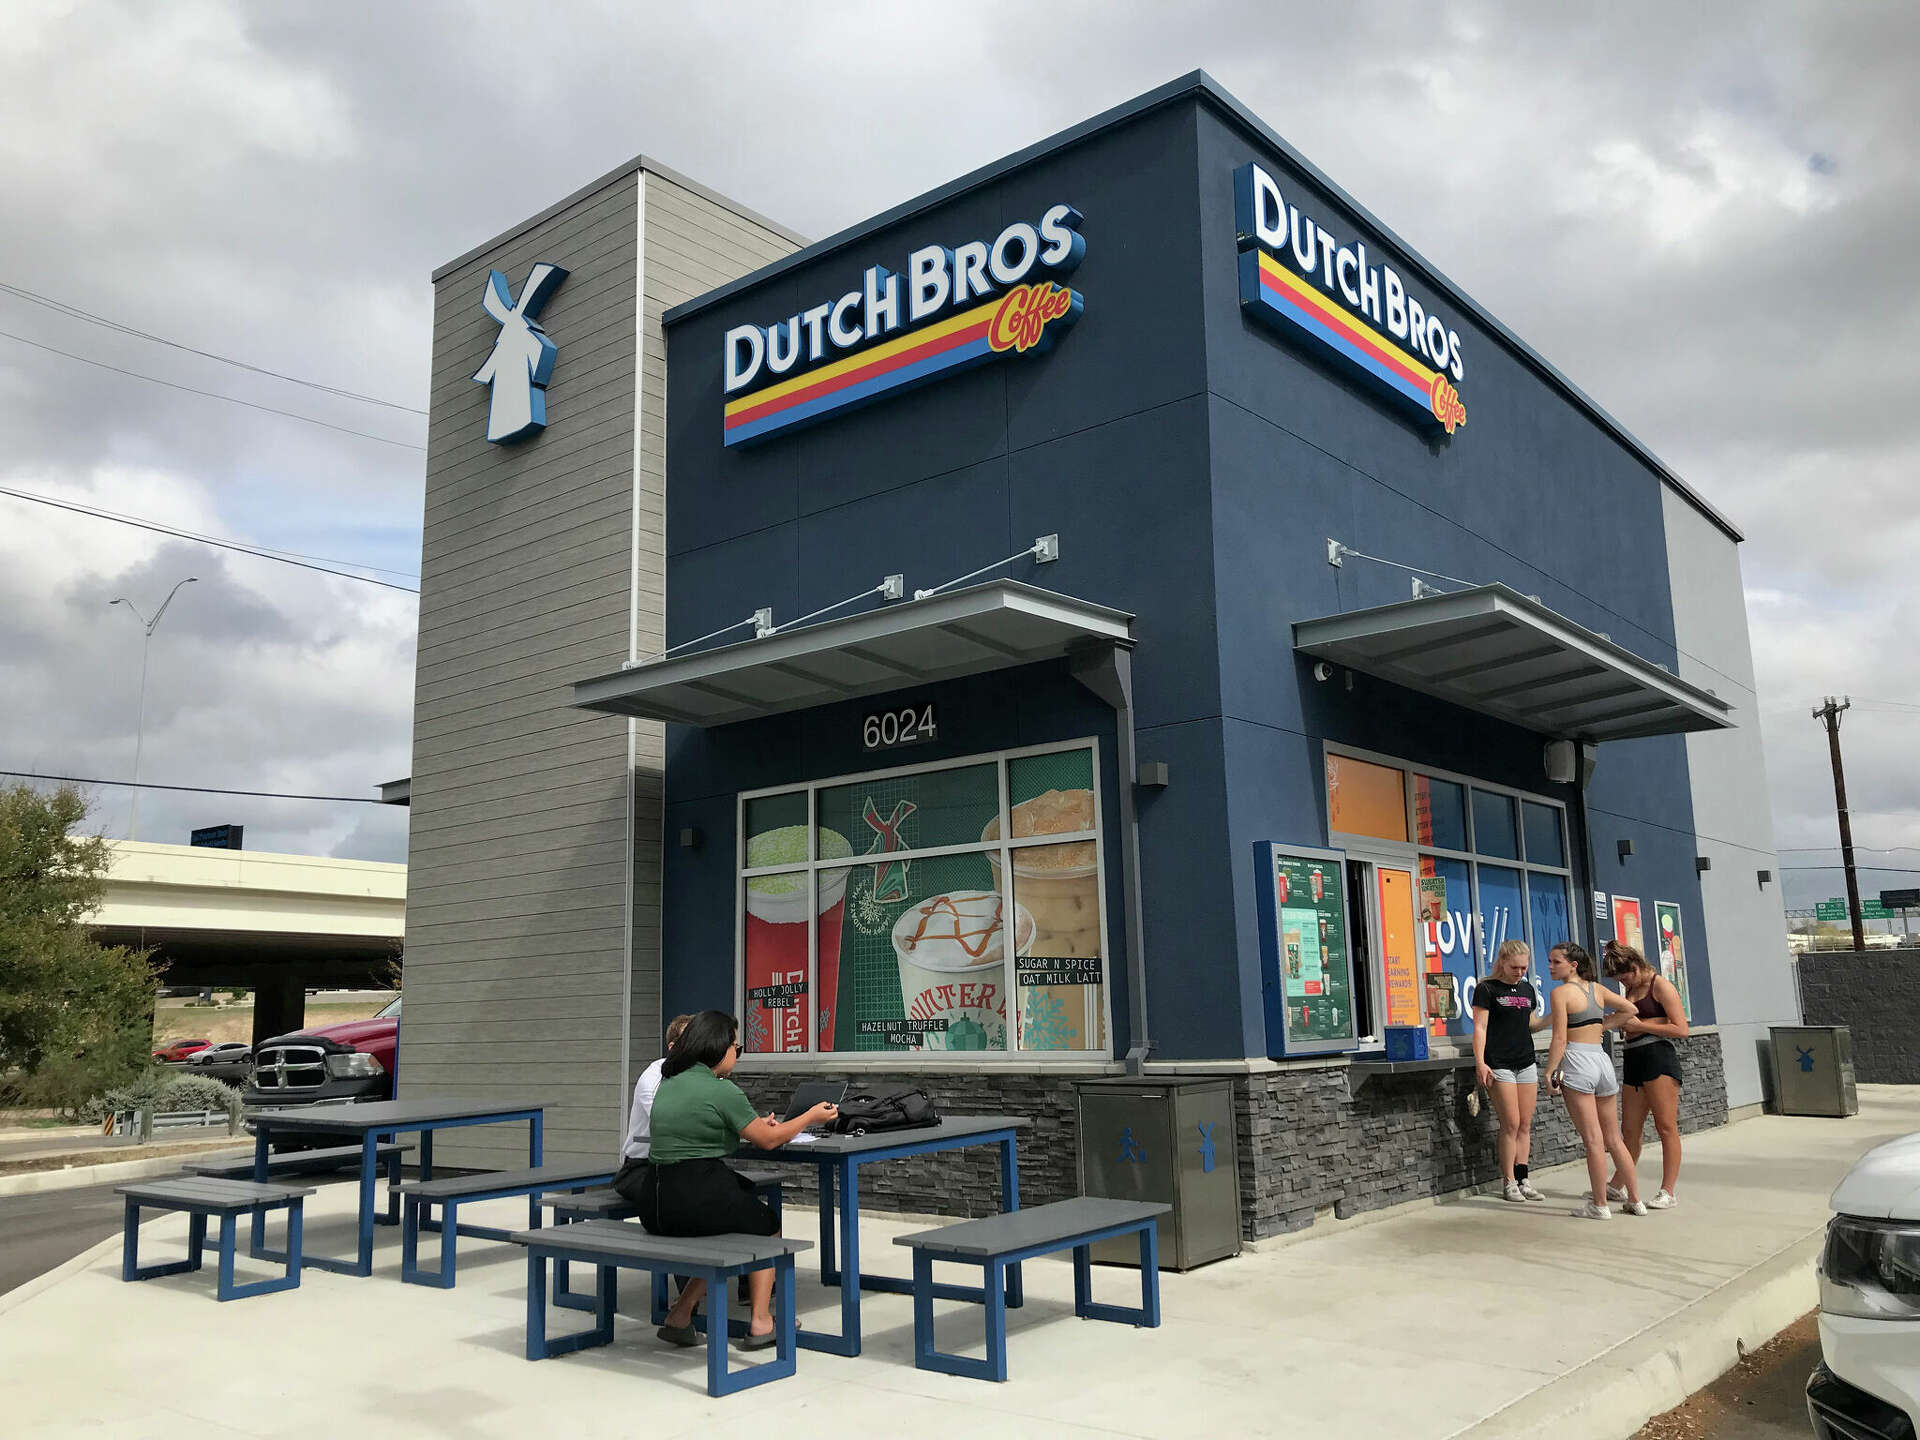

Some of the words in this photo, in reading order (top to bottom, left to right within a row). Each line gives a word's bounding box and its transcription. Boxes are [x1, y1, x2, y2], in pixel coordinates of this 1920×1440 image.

[1252, 163, 1382, 325] DUTCH
[1384, 264, 1464, 382] BROS
[724, 264, 898, 394] DUTCH
[909, 203, 1075, 322] BROS
[989, 284, 1071, 352] Coffee
[1431, 374, 1466, 433] Coffee
[863, 705, 936, 748] 6024
[1019, 958, 1048, 969] SUGAR
[1054, 959, 1060, 969] N
[1065, 959, 1095, 970] SPICE
[1023, 973, 1040, 984] OAT
[1046, 973, 1071, 984] MILK
[753, 986, 776, 998] HOLLY
[781, 983, 804, 995] JOLLY
[767, 997, 790, 1008] REBEL
[786, 970, 803, 1042] DTCH
[861, 1021, 902, 1032] HAZELNUT
[908, 1020, 944, 1031] TRUFFLE
[890, 1033, 917, 1045] MOCHA
